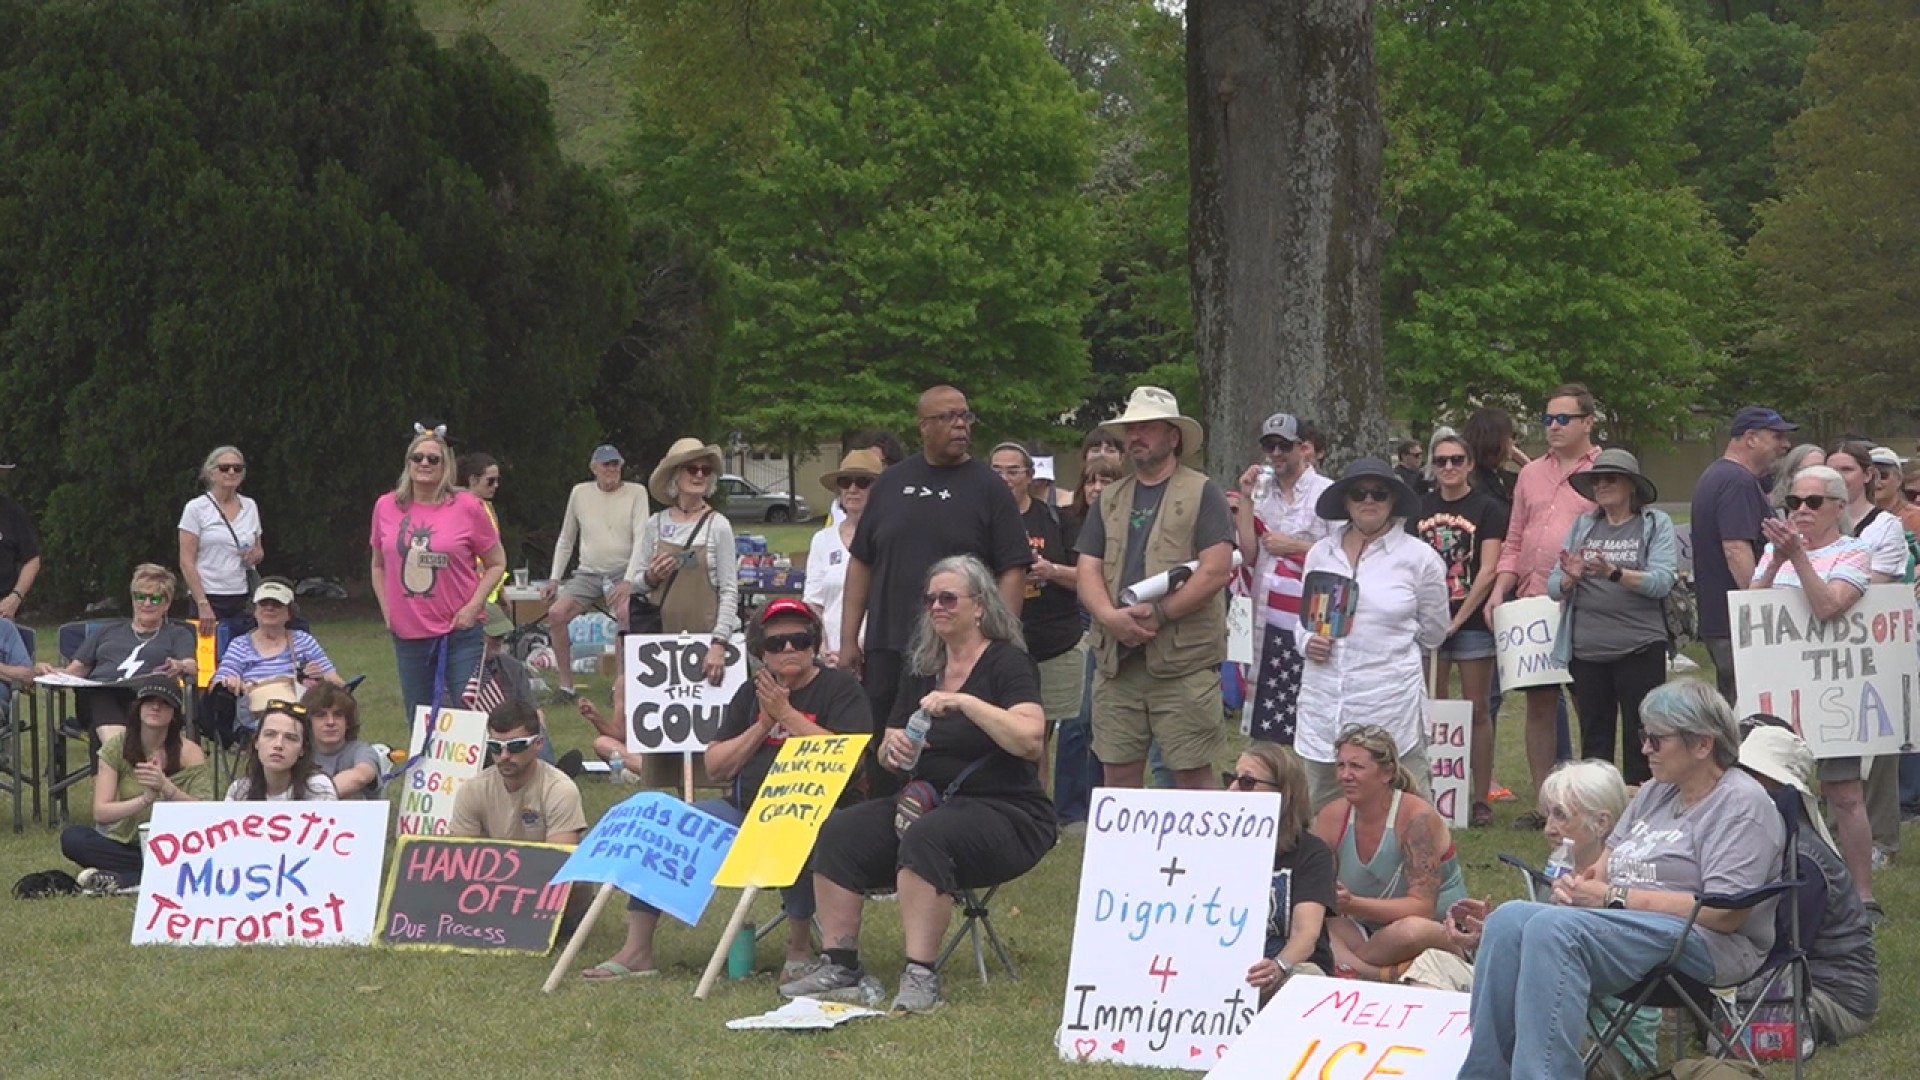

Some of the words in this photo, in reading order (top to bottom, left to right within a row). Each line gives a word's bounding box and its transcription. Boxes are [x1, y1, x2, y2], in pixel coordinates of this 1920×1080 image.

[1739, 603, 1868, 648] HANDS
[1872, 608, 1914, 645] OFF
[636, 642, 741, 687] STOP
[1802, 648, 1877, 681] THE
[664, 685, 704, 700] THE
[632, 701, 730, 748] COU
[424, 738, 480, 766] KINGS
[794, 737, 850, 757] HATE
[413, 768, 464, 795] 864
[406, 791, 433, 814] NO
[1094, 795, 1275, 851] Compassion
[147, 811, 356, 867] Domestic
[400, 815, 450, 836] KING
[407, 845, 521, 882] HANDS
[146, 893, 346, 943] Terrorist
[1095, 886, 1249, 948] Dignity
[1148, 954, 1178, 994] 4
[1067, 985, 1255, 1051] Immigrants
[1302, 990, 1424, 1031] MELT
[1287, 1037, 1427, 1080] ICE
